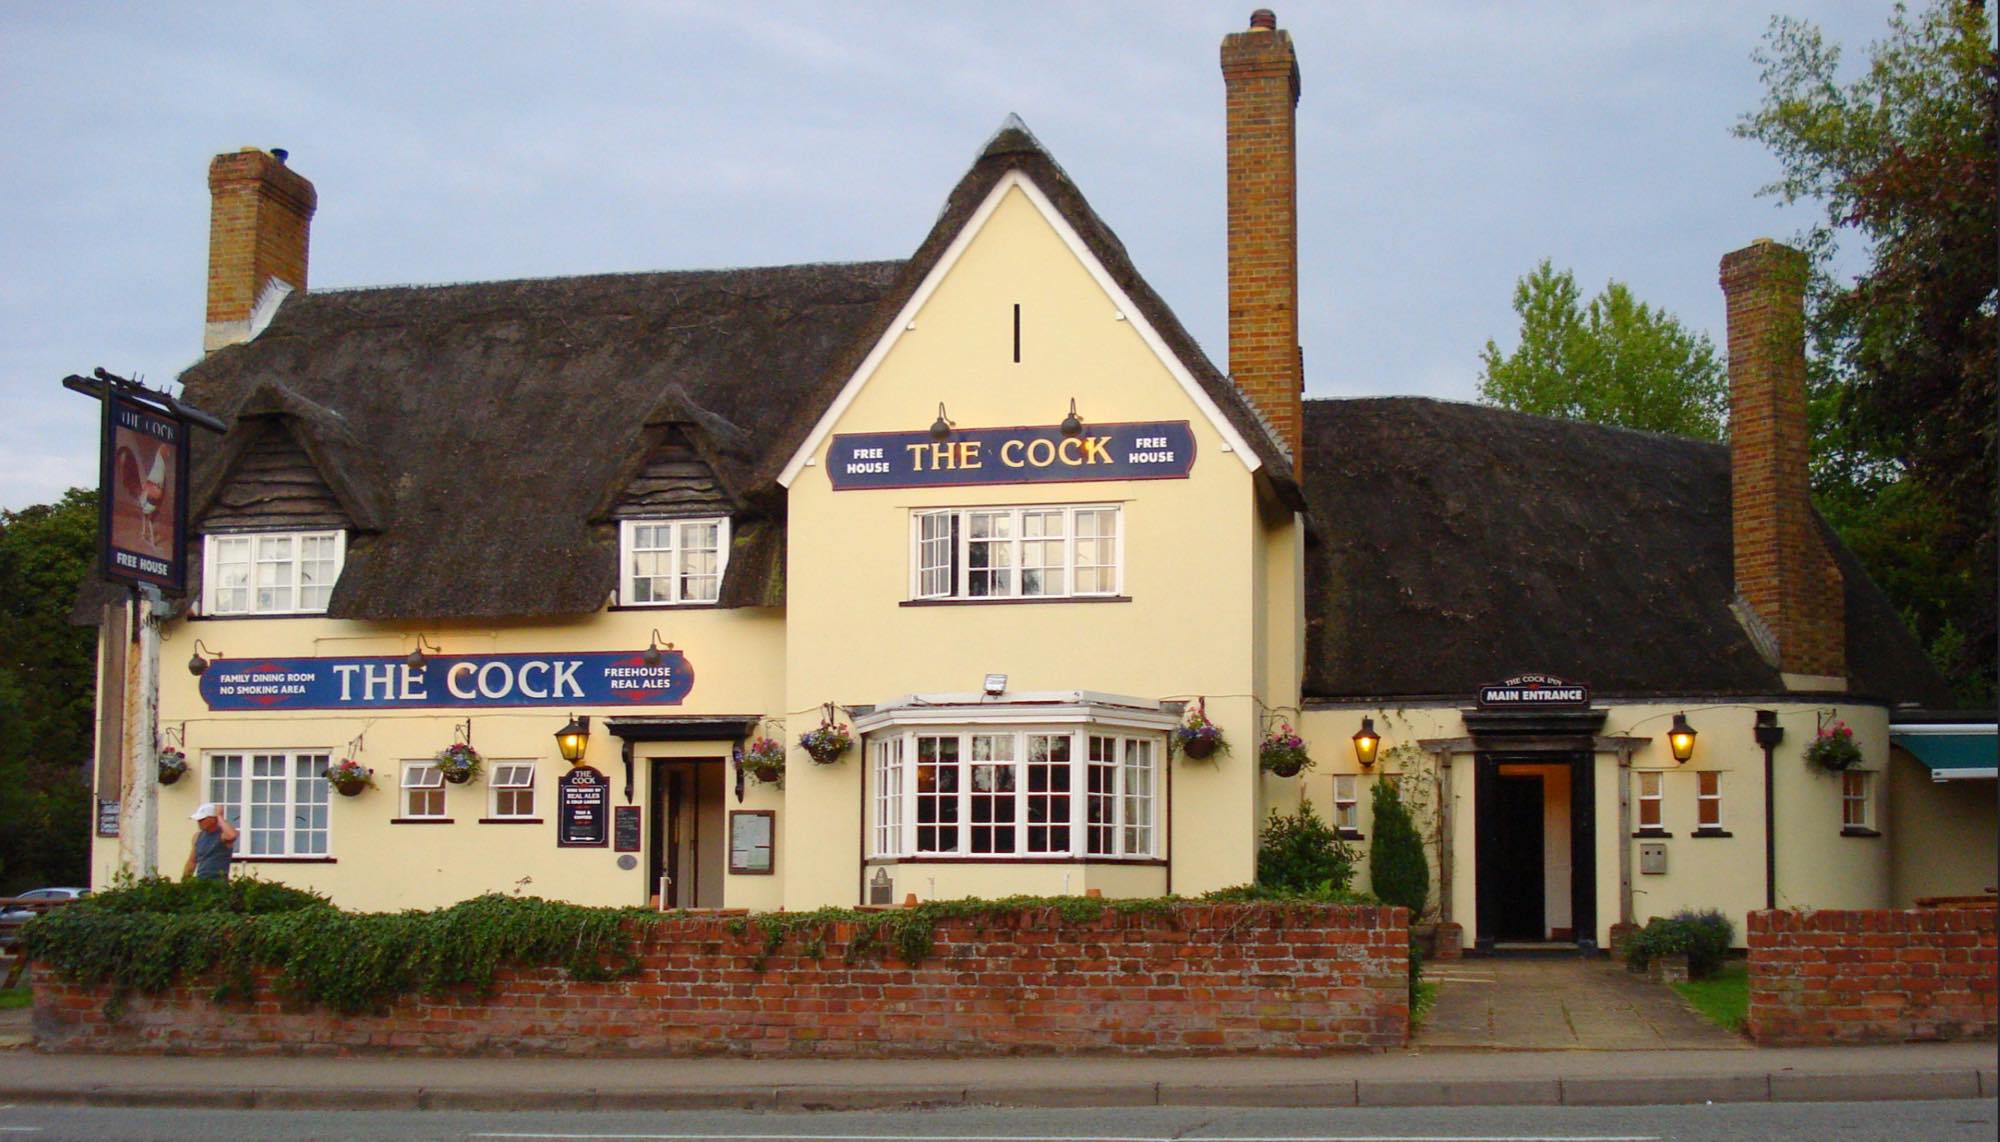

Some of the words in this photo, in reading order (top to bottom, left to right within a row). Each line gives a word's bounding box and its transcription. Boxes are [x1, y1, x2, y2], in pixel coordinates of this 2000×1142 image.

[1135, 437, 1167, 449] FREE
[853, 448, 884, 459] FREE
[906, 441, 982, 471] THE
[1000, 436, 1114, 468] COCK
[1128, 452, 1174, 463] HOUSE
[846, 462, 890, 474] HOUSE
[117, 552, 137, 568] FREE
[140, 558, 168, 576] HOUSE
[220, 674, 251, 683] FAMILY
[252, 673, 285, 682] DINING
[287, 673, 315, 682] ROOM
[604, 667, 671, 677] FREEHOUSE
[333, 664, 427, 700] THE
[447, 660, 585, 698] COCK
[611, 679, 640, 689] REAL
[642, 678, 671, 688] ALES
[1505, 678, 1521, 687] THE
[1522, 675, 1545, 683] COCK
[220, 686, 235, 695] NO
[236, 685, 279, 694] SMOKING
[280, 685, 306, 694] AREA
[1486, 690, 1519, 701] MAIN
[1522, 689, 1583, 700] ENTRANCE
